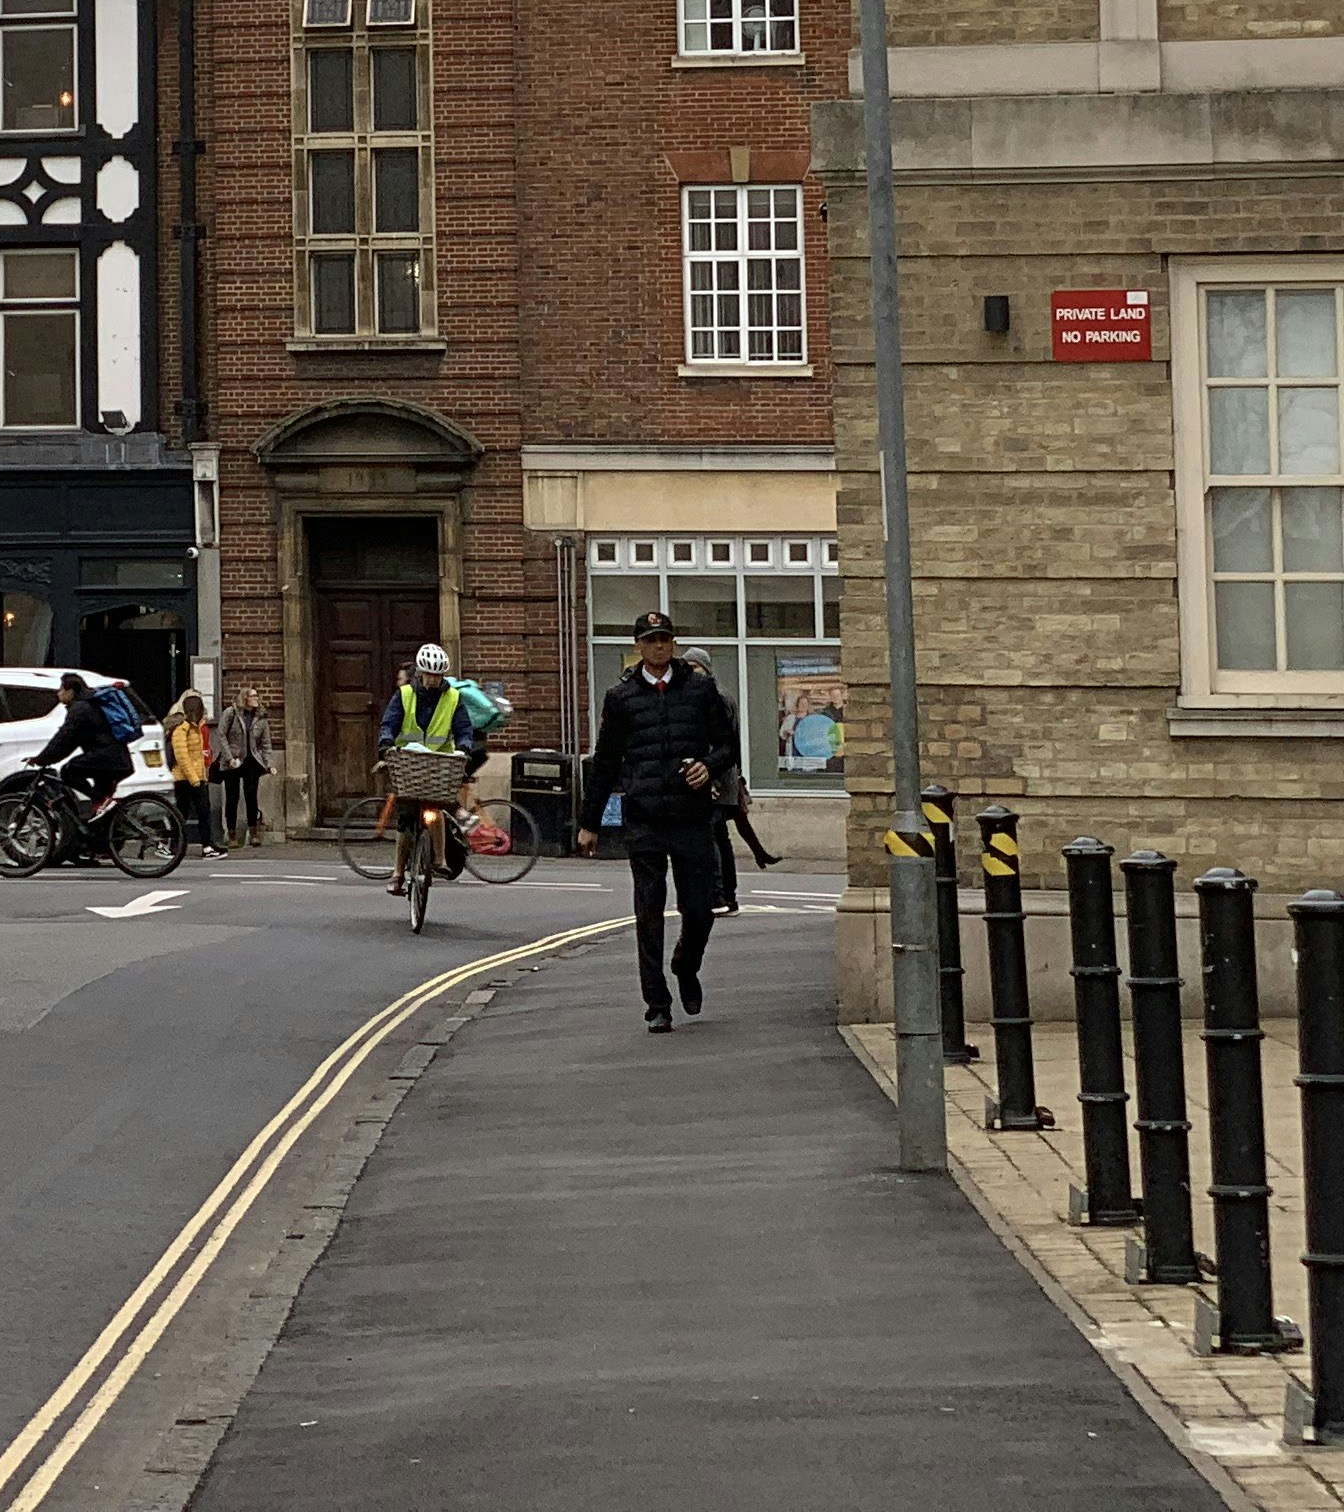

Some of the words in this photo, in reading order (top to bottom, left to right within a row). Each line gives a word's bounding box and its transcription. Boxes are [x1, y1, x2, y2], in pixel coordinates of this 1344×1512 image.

[1055, 308, 1106, 321] PRIVATE
[1110, 307, 1146, 320] LAND
[1061, 330, 1081, 343] NO
[1085, 330, 1141, 343] PARKING
